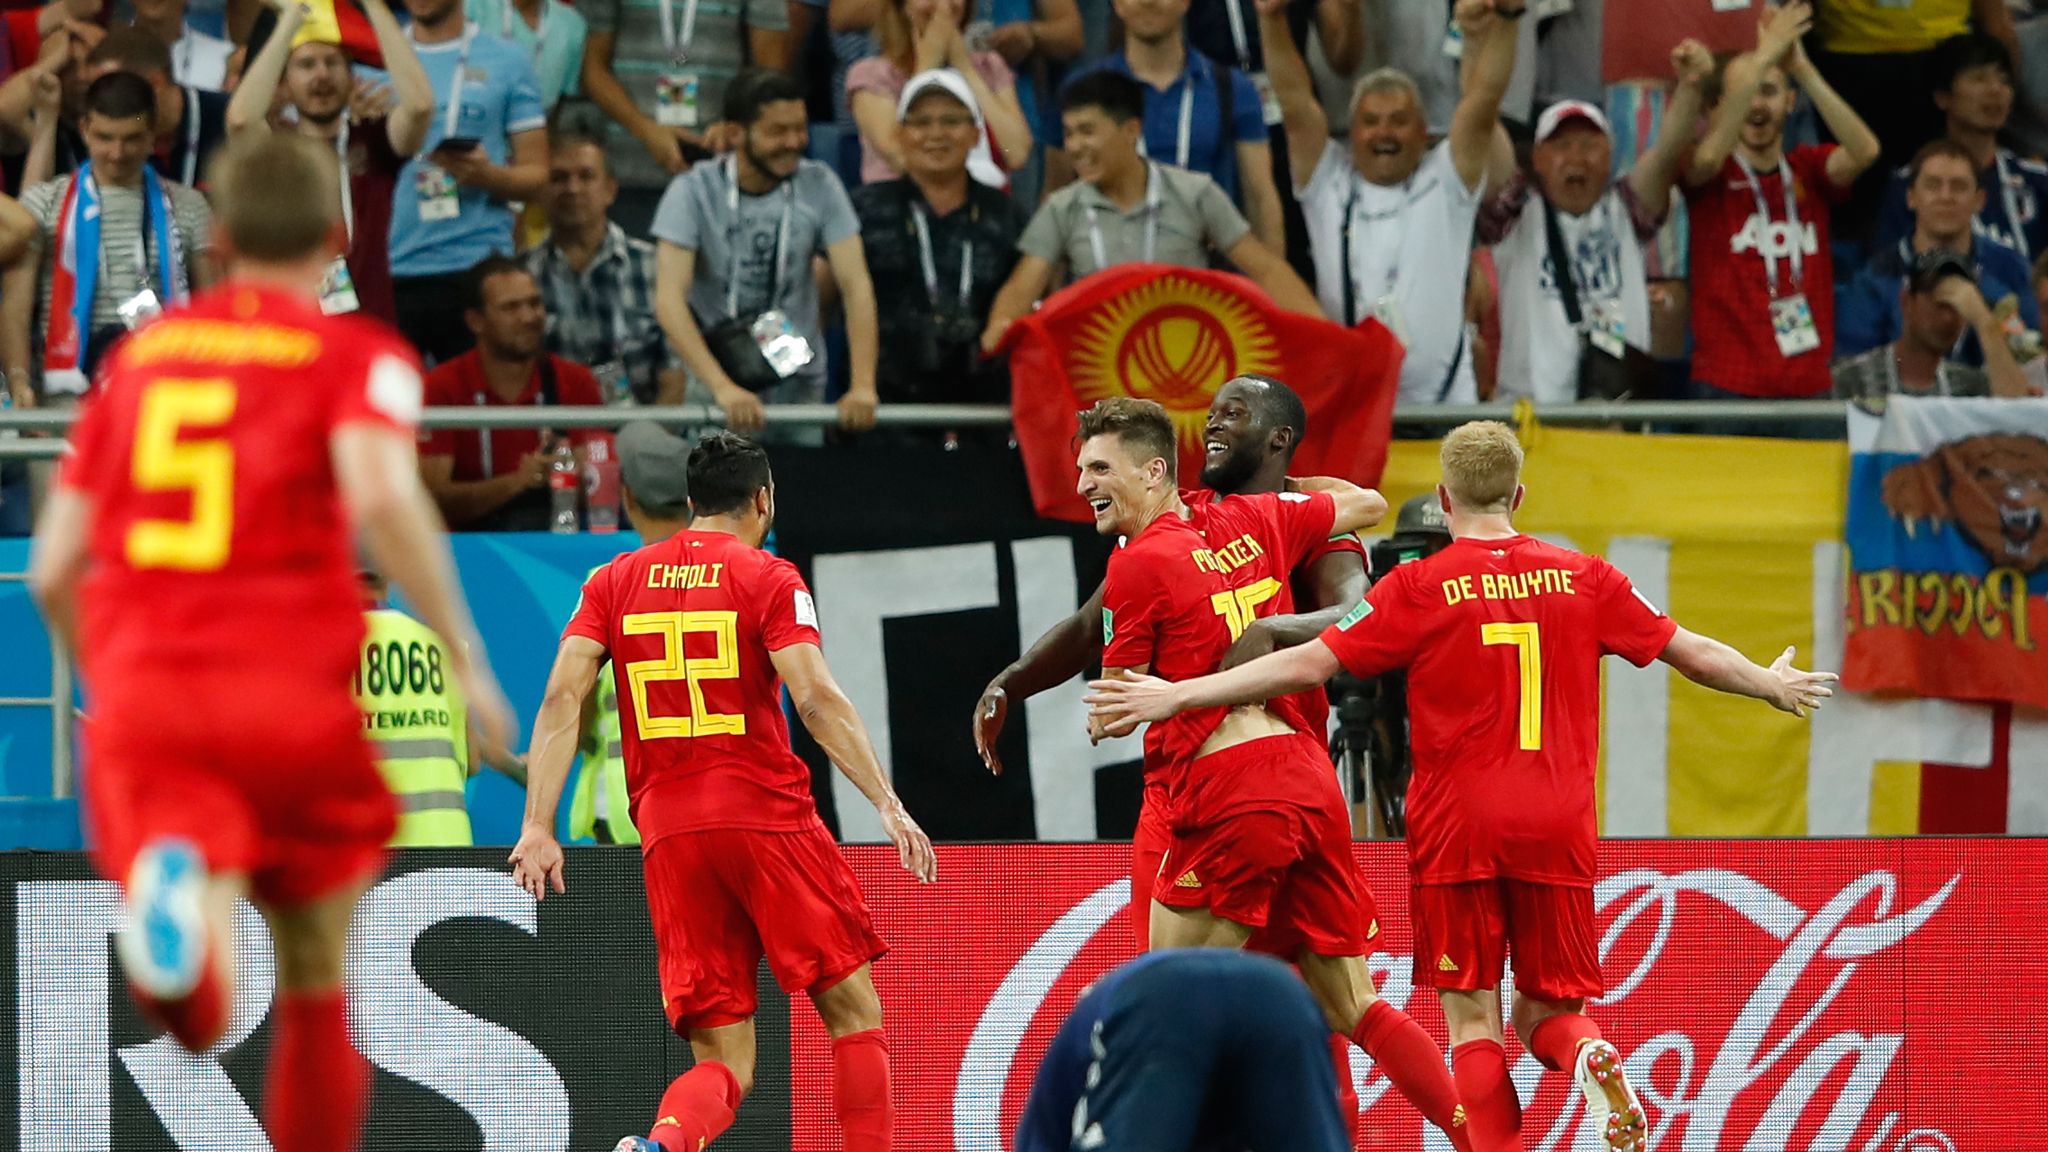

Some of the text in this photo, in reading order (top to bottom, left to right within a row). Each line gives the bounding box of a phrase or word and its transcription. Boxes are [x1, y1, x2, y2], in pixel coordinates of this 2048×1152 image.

[1730, 213, 1818, 258] AON
[126, 377, 238, 570] 5
[1442, 568, 1576, 606] DE BRUYNE
[623, 610, 746, 740] 22
[1481, 622, 1541, 750] 7
[363, 709, 450, 730] TEWARD
